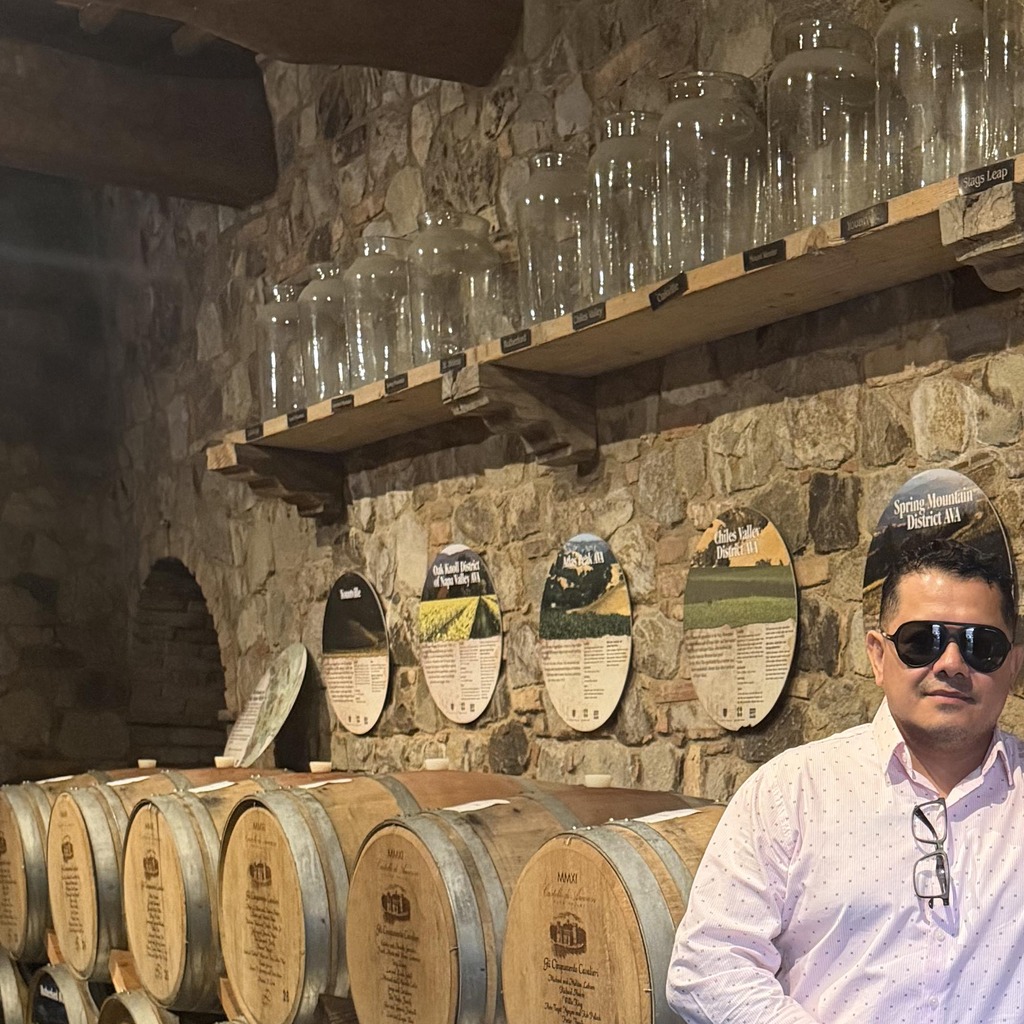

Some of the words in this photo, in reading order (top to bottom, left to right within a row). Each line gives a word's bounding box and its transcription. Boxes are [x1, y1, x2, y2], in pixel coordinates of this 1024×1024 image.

[987, 168, 1008, 180] Leap
[893, 496, 926, 519] Spring
[927, 487, 974, 510] Mountain
[906, 510, 941, 531] District
[943, 506, 962, 525] AVA
[714, 528, 737, 545] Chiles
